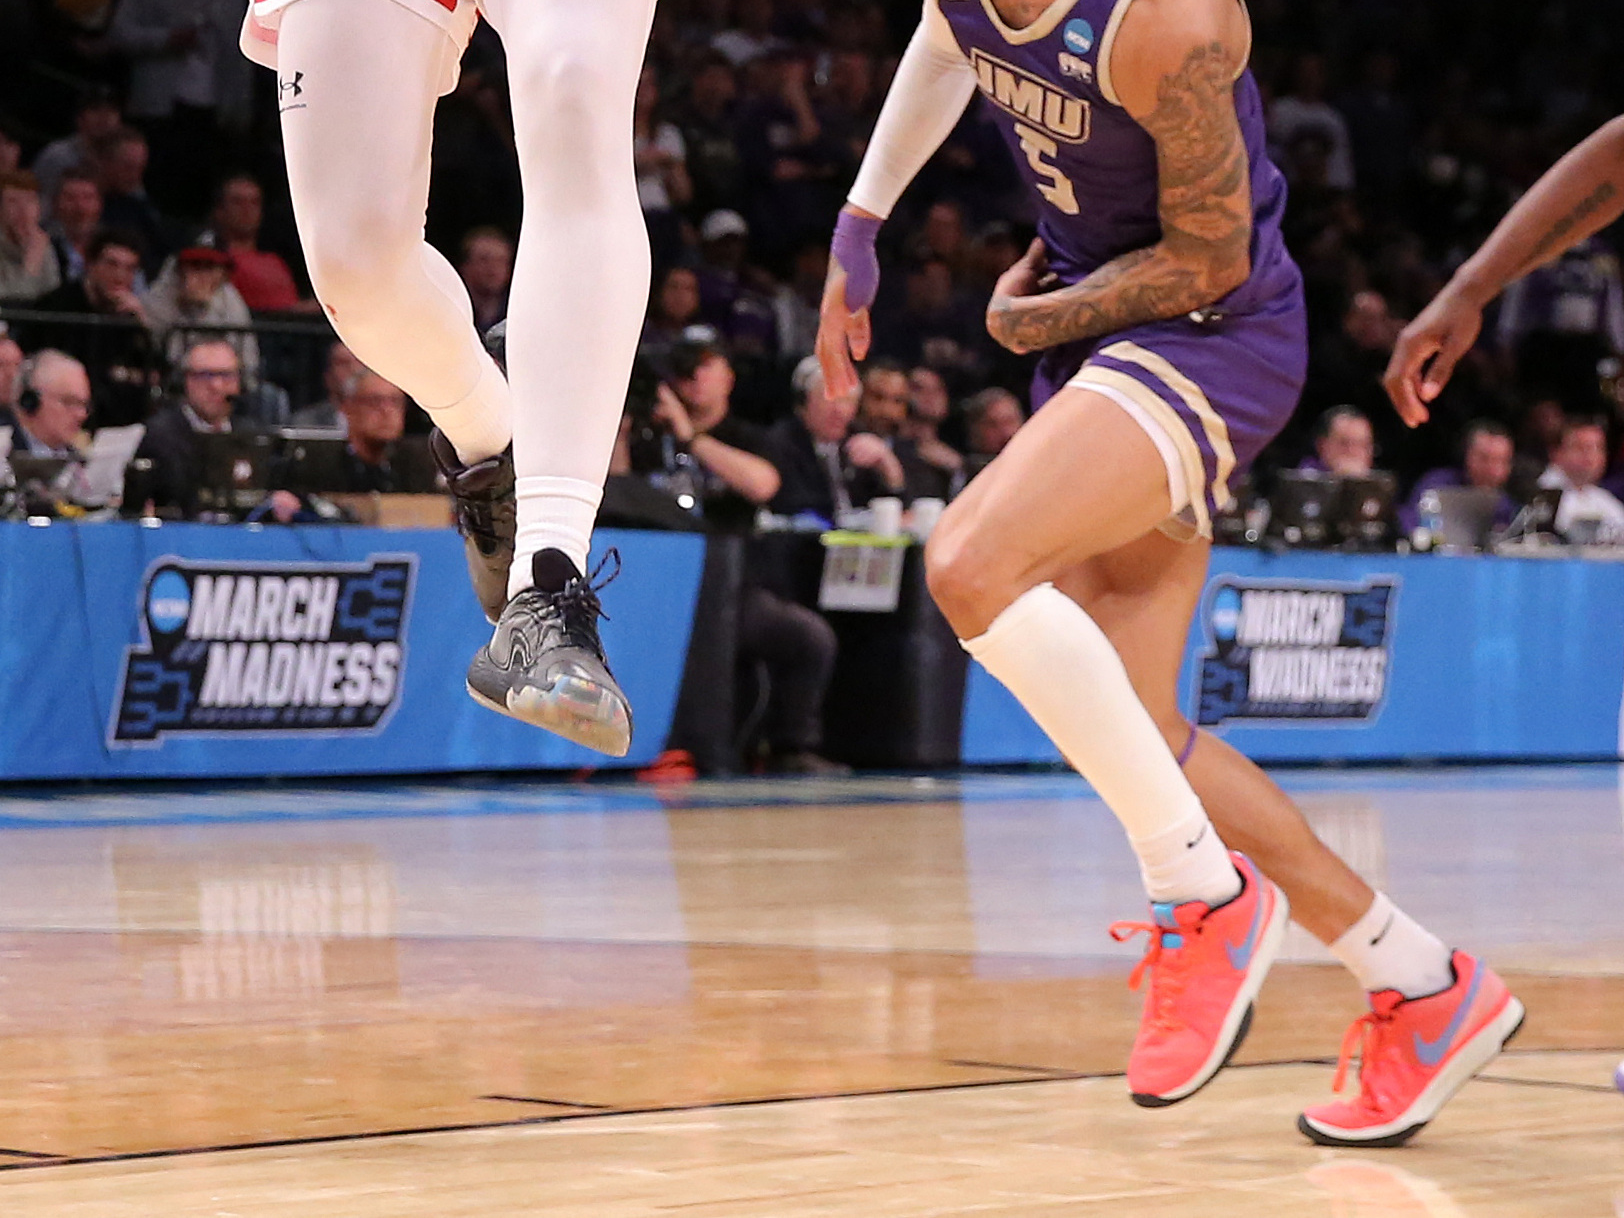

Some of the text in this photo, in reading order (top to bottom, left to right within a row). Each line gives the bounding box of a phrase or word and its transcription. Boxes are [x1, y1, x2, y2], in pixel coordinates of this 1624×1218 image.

[1013, 122, 1080, 215] 5
[186, 575, 339, 641] MARCH
[1236, 590, 1345, 646] MARCH
[199, 641, 400, 707] MADNESS
[1249, 646, 1386, 702] MADNESS
